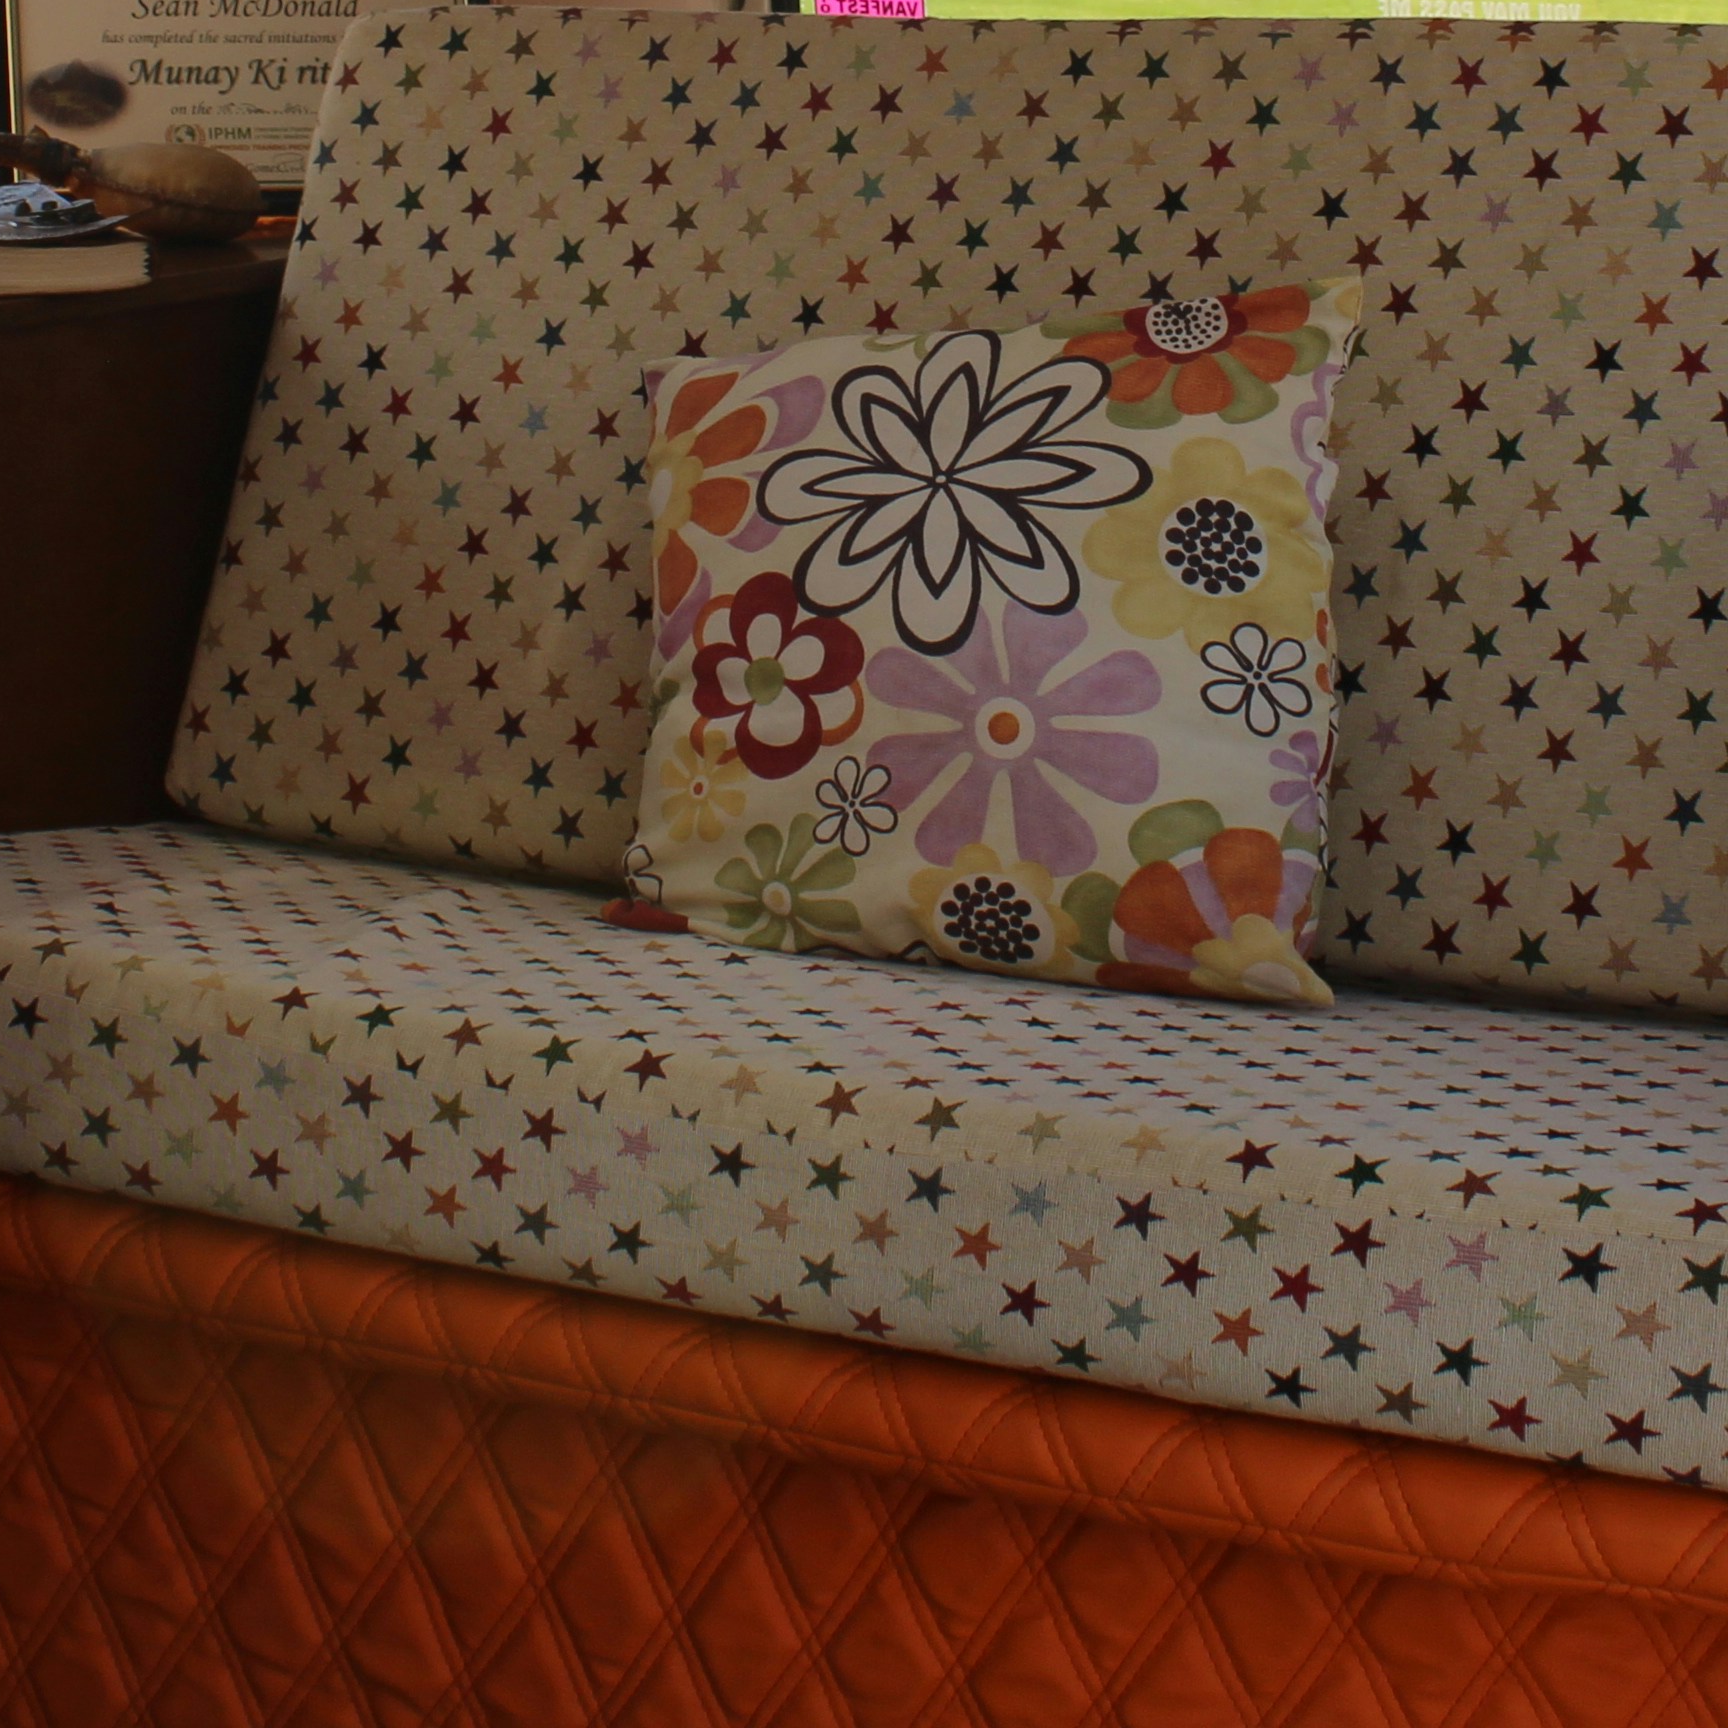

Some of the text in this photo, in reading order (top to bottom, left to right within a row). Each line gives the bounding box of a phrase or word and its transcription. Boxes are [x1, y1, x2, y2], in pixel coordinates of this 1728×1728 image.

[101, 28, 338, 48] has completed the sacred initiations
[128, 56, 332, 95] Munay Ki rit
[170, 104, 187, 116] on
[190, 100, 214, 116] the
[208, 126, 252, 140] IPHM
